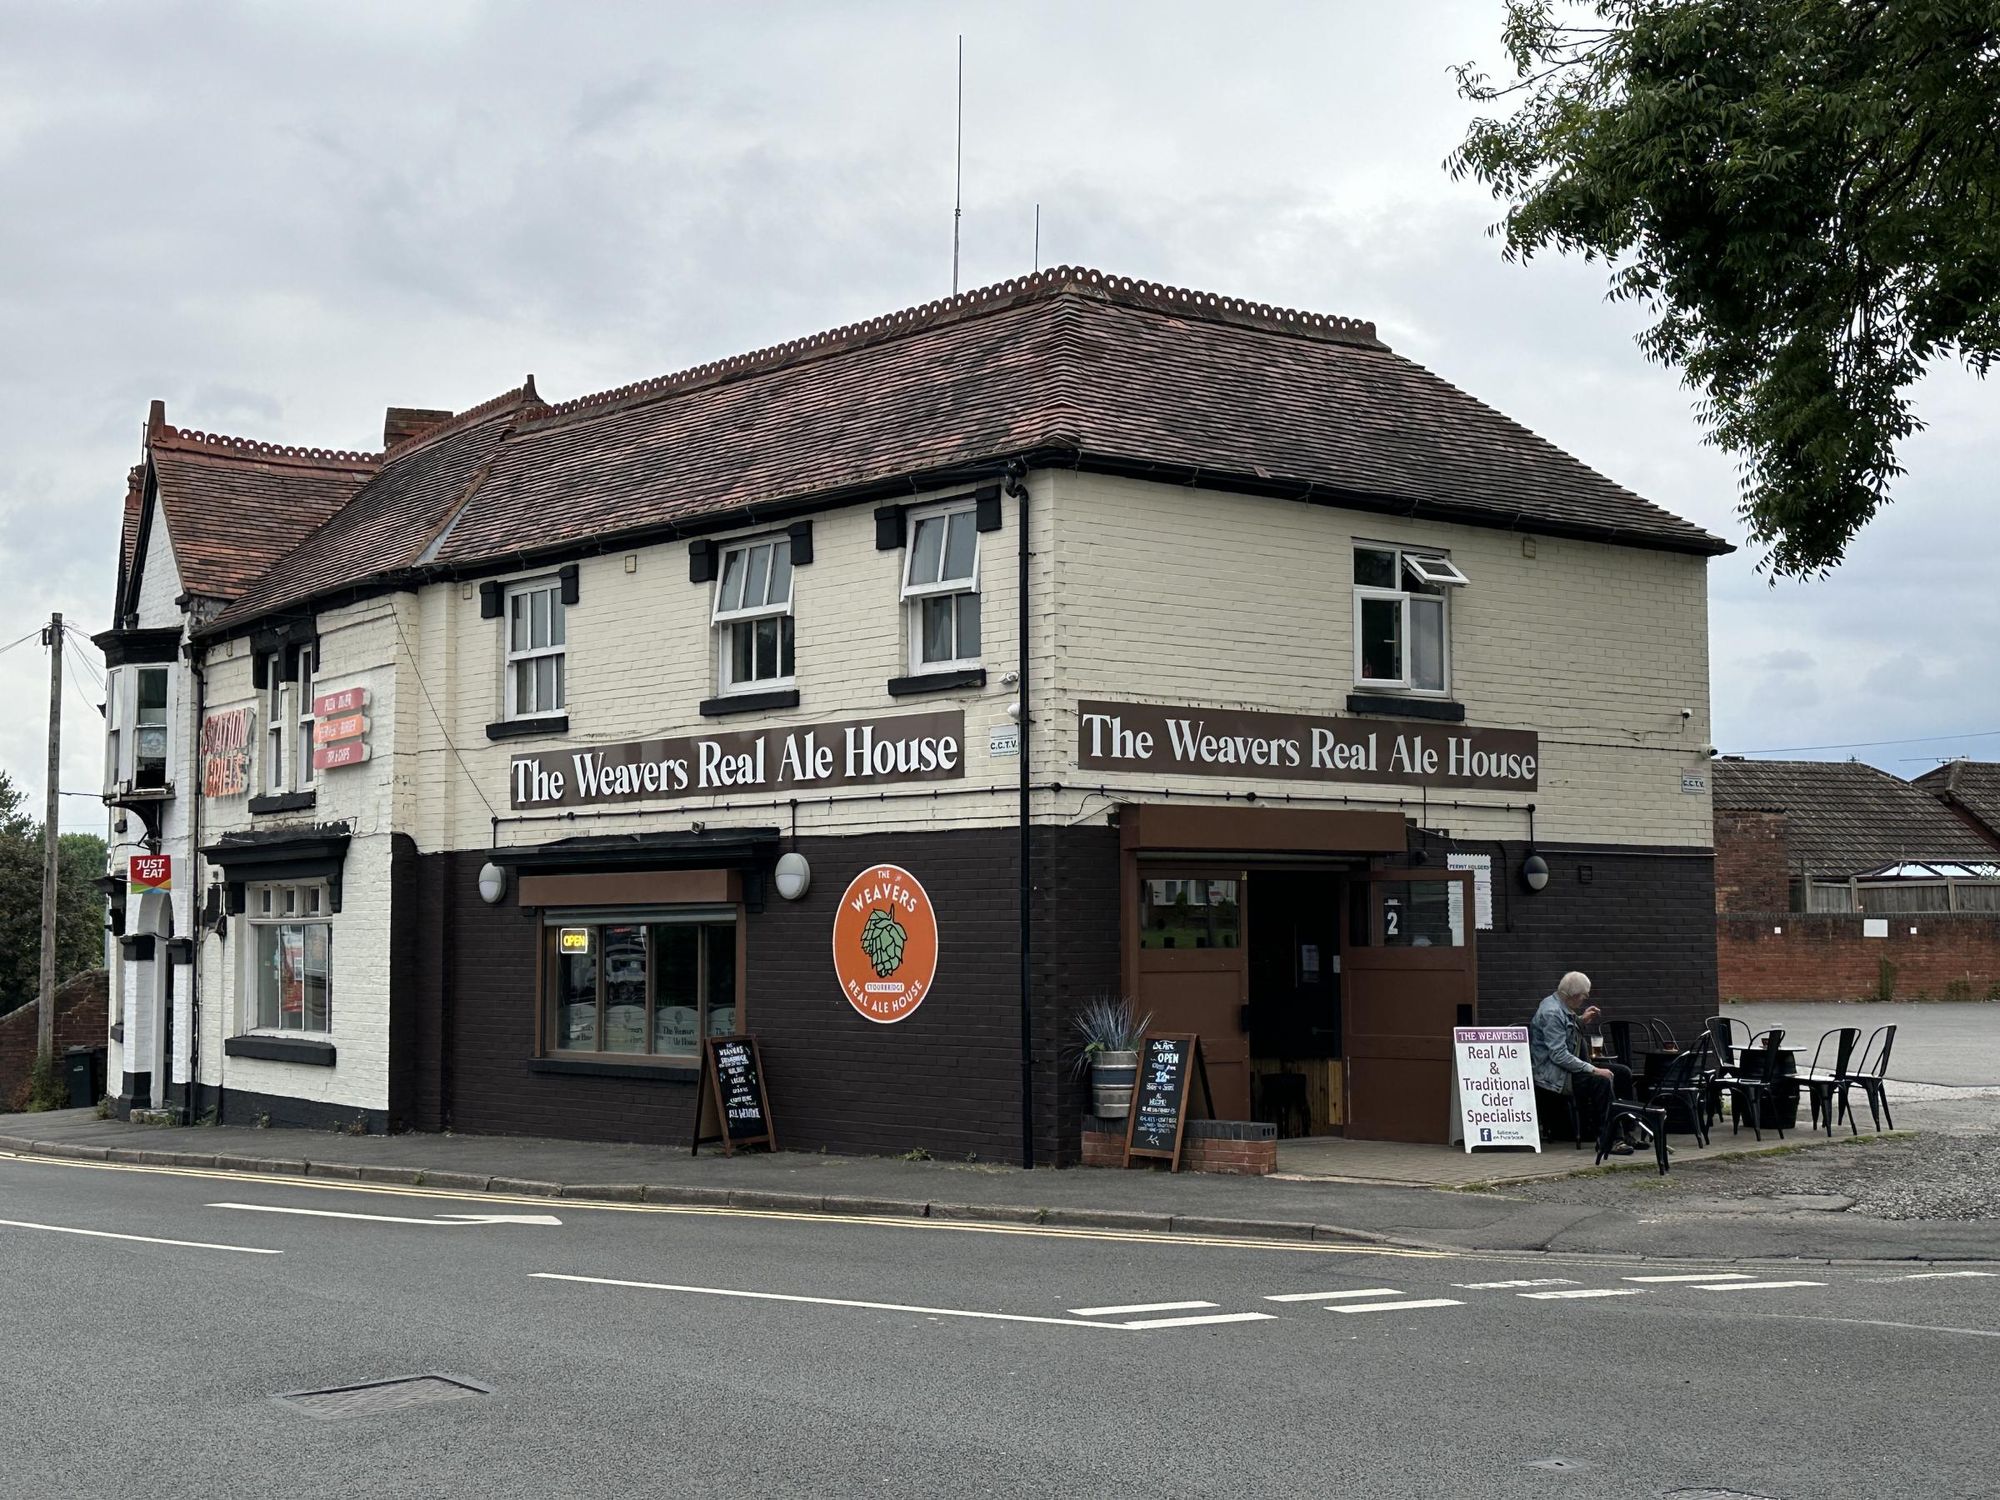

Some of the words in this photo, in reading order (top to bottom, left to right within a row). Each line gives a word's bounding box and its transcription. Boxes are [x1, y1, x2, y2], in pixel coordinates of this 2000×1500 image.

[1081, 713, 1154, 759] The
[1165, 718, 1300, 767] Weavers
[1311, 727, 1378, 771] Real
[1388, 734, 1438, 774] Ale
[1447, 737, 1536, 780] House
[512, 757, 564, 803] The
[571, 751, 688, 798] Weavers
[698, 735, 766, 788] Real
[776, 730, 833, 782] Ale
[844, 725, 958, 777] House
[136, 859, 165, 871] JUST
[142, 868, 165, 878] EAT
[877, 870, 890, 879] THE
[852, 883, 917, 913] WEAVERS
[1387, 911, 1399, 935] 2
[563, 935, 586, 947] OPEN
[848, 979, 868, 1007] REAL
[871, 1002, 889, 1014] ALE
[892, 979, 923, 1013] HOUSE
[1458, 1031, 1477, 1041] THE
[1477, 1031, 1518, 1041] WEAVERS
[1157, 1053, 1179, 1064] OPEN
[1468, 1046, 1493, 1059] Real
[1498, 1045, 1518, 1059] Ale
[1489, 1062, 1500, 1075] &
[1463, 1077, 1530, 1091] Traditional
[1481, 1093, 1514, 1107] Cider
[1467, 1109, 1532, 1125] Specialists
